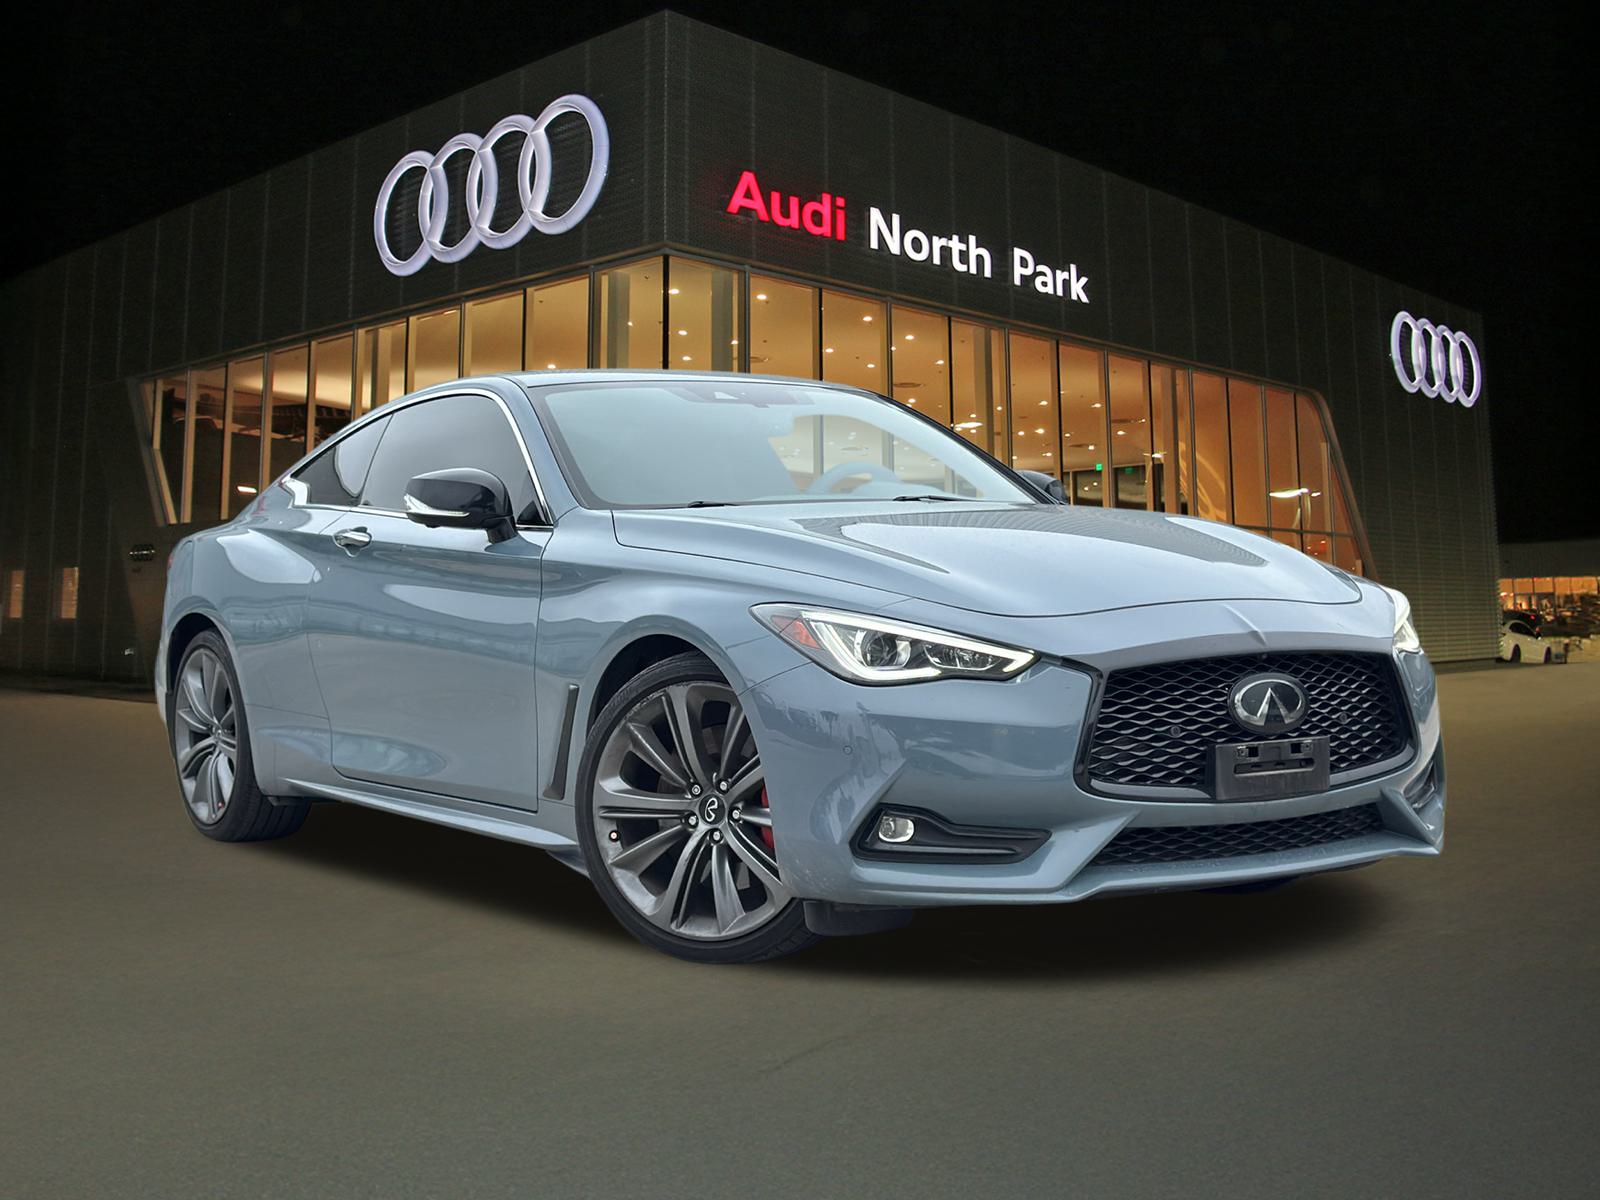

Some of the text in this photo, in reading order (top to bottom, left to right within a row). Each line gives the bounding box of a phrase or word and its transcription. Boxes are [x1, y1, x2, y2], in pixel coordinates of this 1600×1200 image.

[726, 171, 1090, 304] Audi North Park
